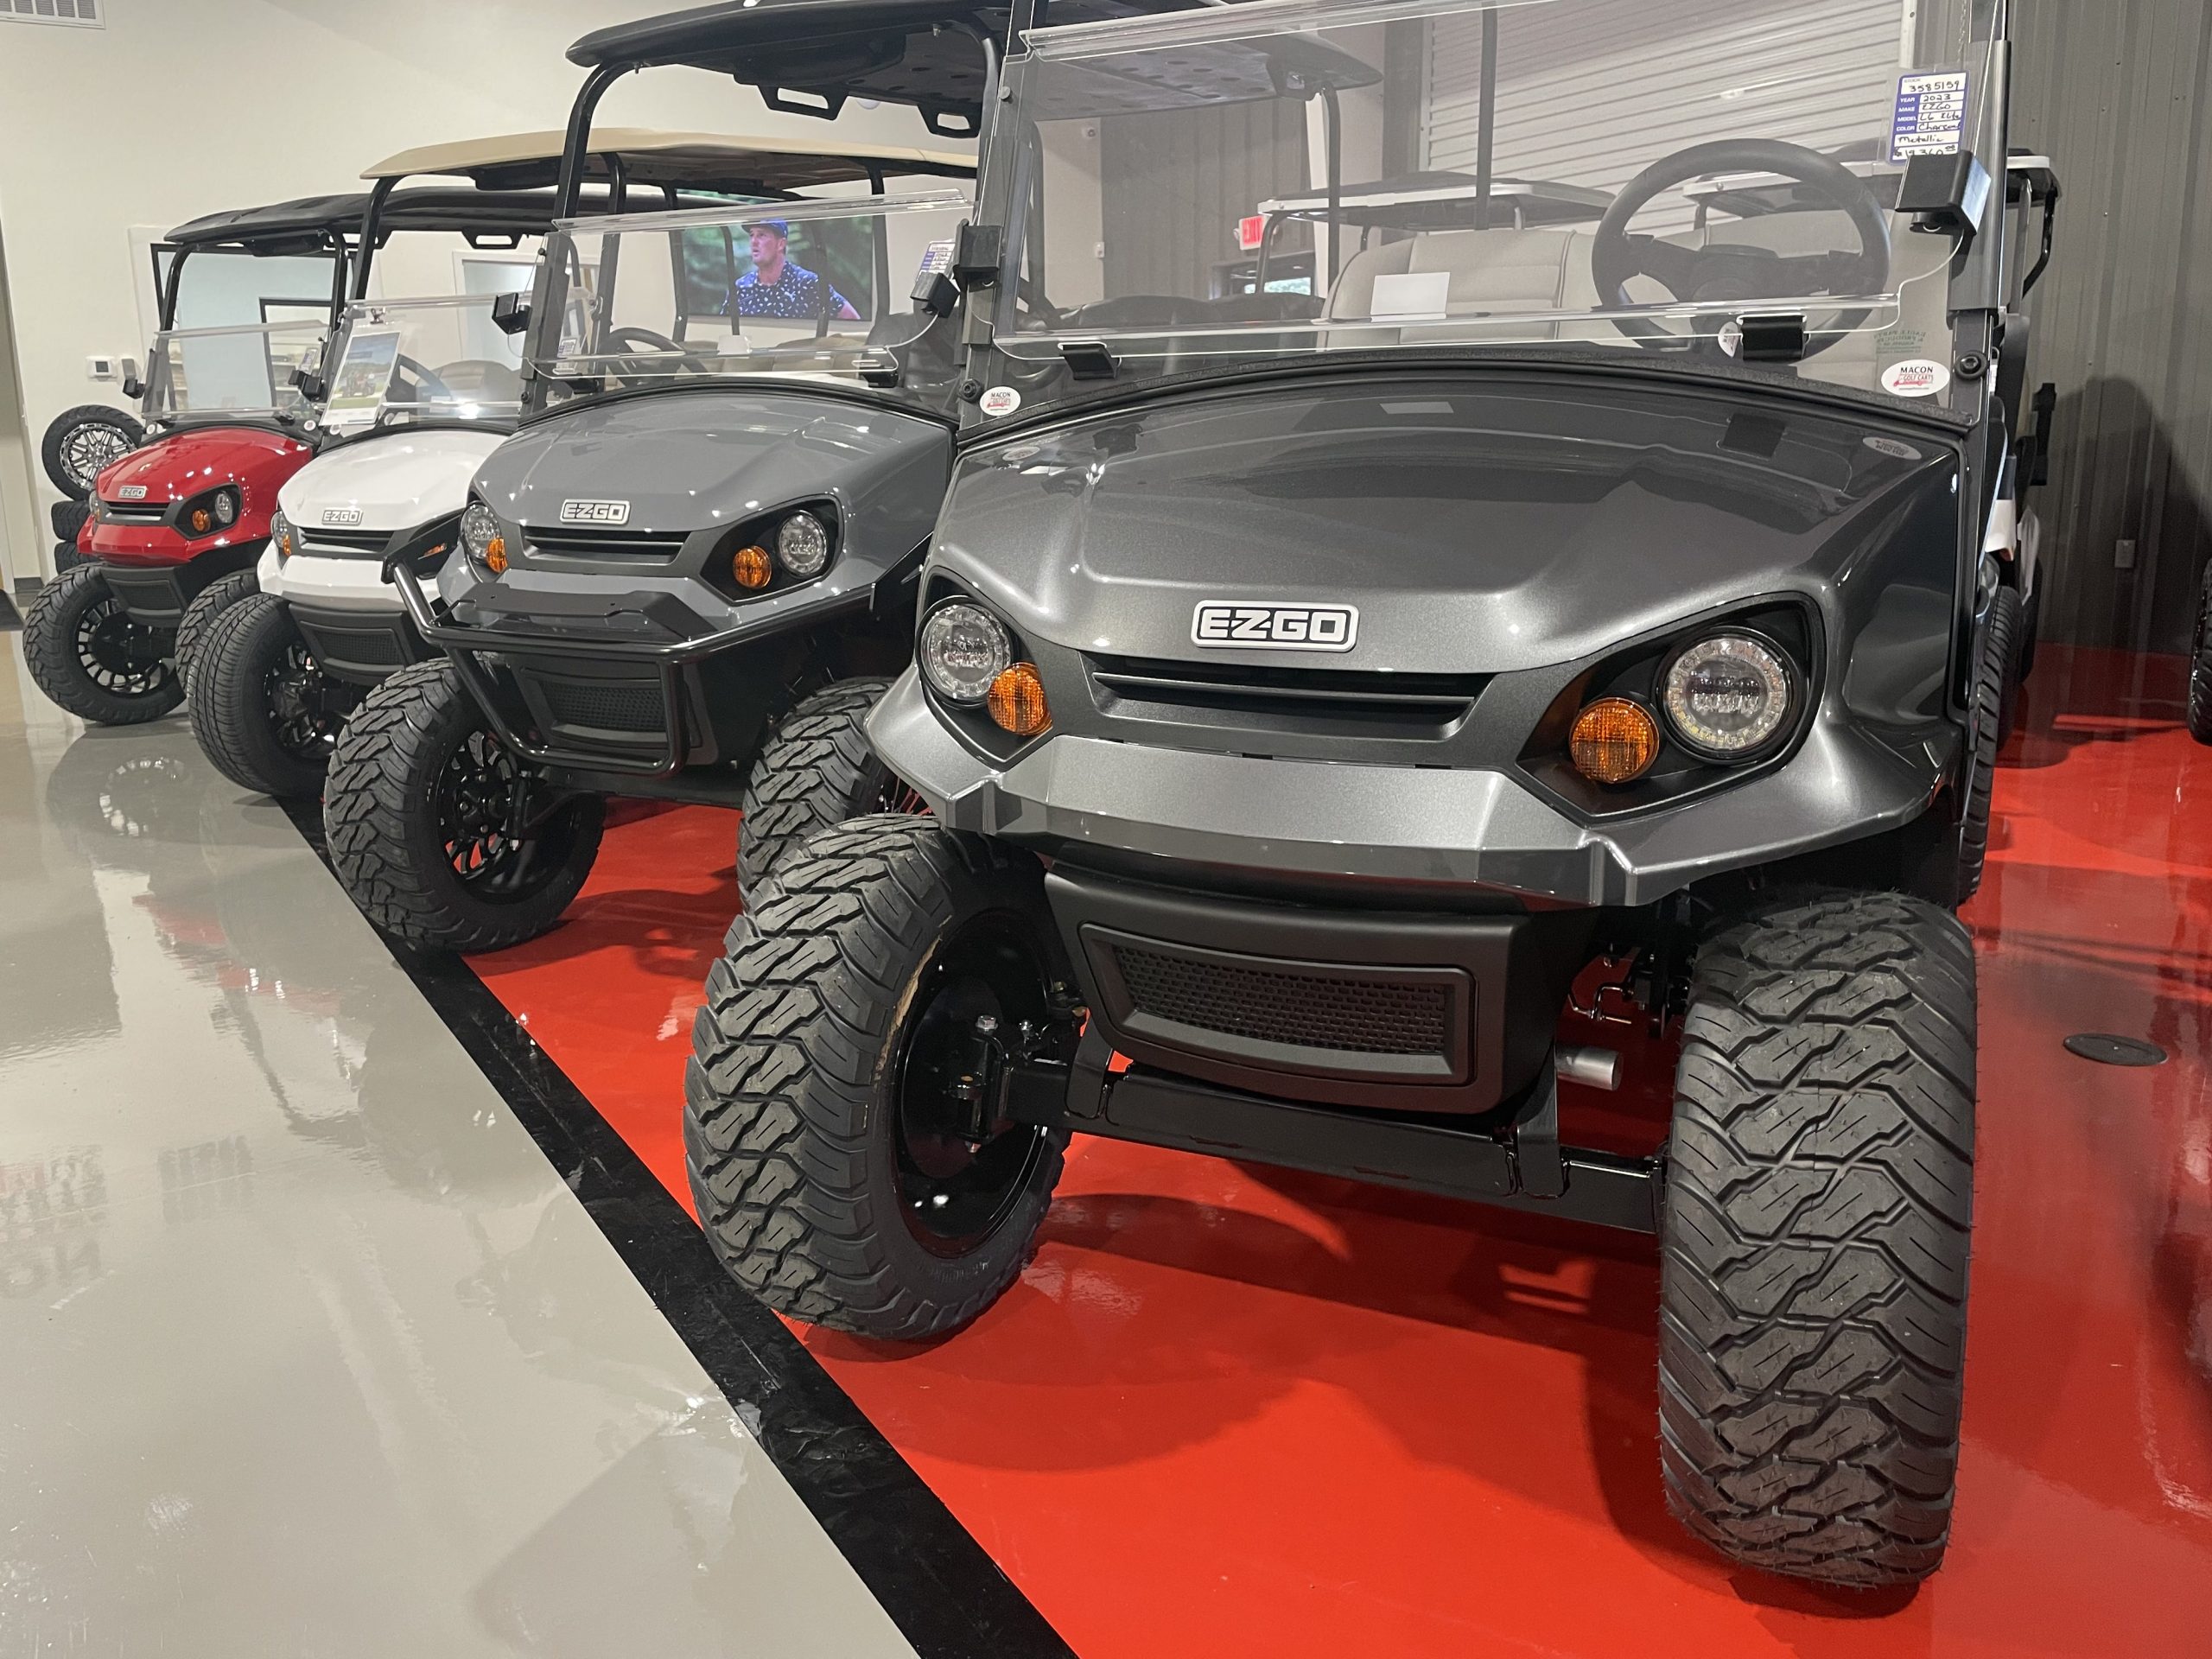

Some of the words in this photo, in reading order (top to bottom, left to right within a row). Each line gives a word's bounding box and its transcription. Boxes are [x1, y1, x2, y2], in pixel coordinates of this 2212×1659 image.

[1909, 80, 1960, 92] 3585159
[1923, 93, 1951, 102] 2023
[1898, 135, 1944, 143] Metallic
[1900, 365, 1934, 374] MACON
[119, 487, 144, 497] EZGO
[323, 511, 359, 522] EZGO
[563, 503, 626, 520] EZGO
[1199, 608, 1347, 642] EZGO
